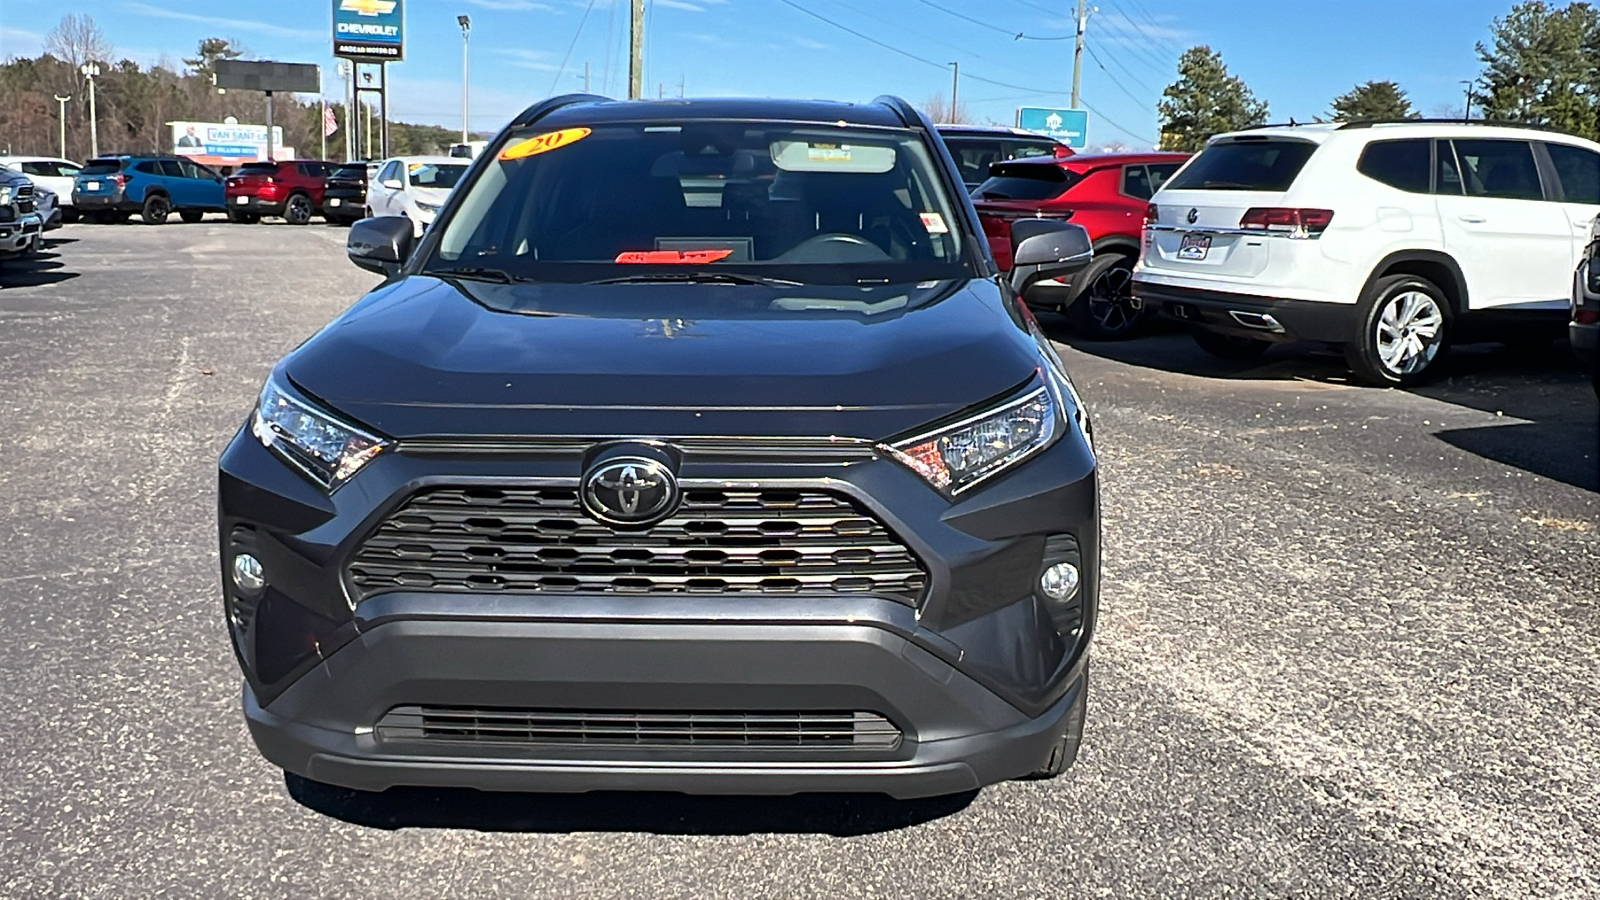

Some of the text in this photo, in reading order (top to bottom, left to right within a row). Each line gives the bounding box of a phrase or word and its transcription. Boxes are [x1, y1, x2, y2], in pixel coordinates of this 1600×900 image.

[338, 23, 398, 36] CHEVROLET
[211, 131, 230, 139] VAN
[232, 131, 254, 140] SANT
[527, 133, 563, 153] 20
